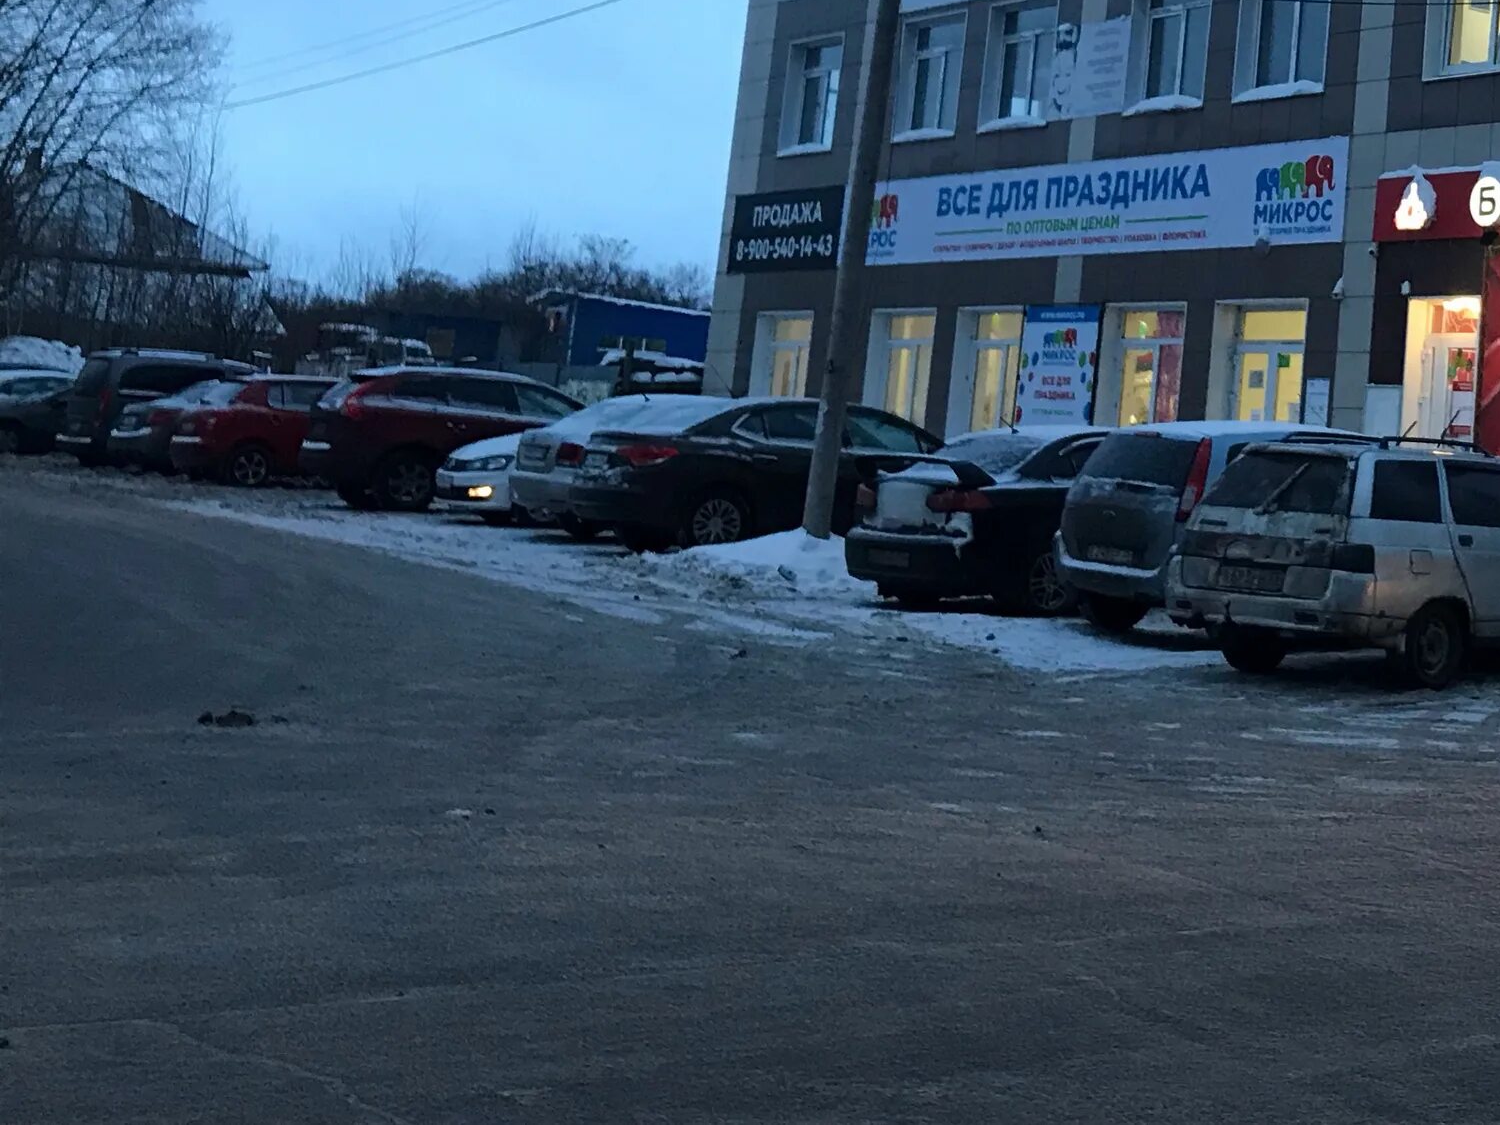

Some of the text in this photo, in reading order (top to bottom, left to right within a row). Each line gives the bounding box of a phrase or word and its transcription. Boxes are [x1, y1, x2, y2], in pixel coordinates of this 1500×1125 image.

[936, 163, 1211, 219] ВСЕ ДЛЯ ПРАЗДНИКА
[752, 200, 823, 229] ПРОДАЖА
[1006, 215, 1120, 235] ПО ОПТОВЫМ ЦЕНАМ
[1253, 199, 1334, 225] МИКРОС
[736, 234, 833, 261] 8-900-540-14-43
